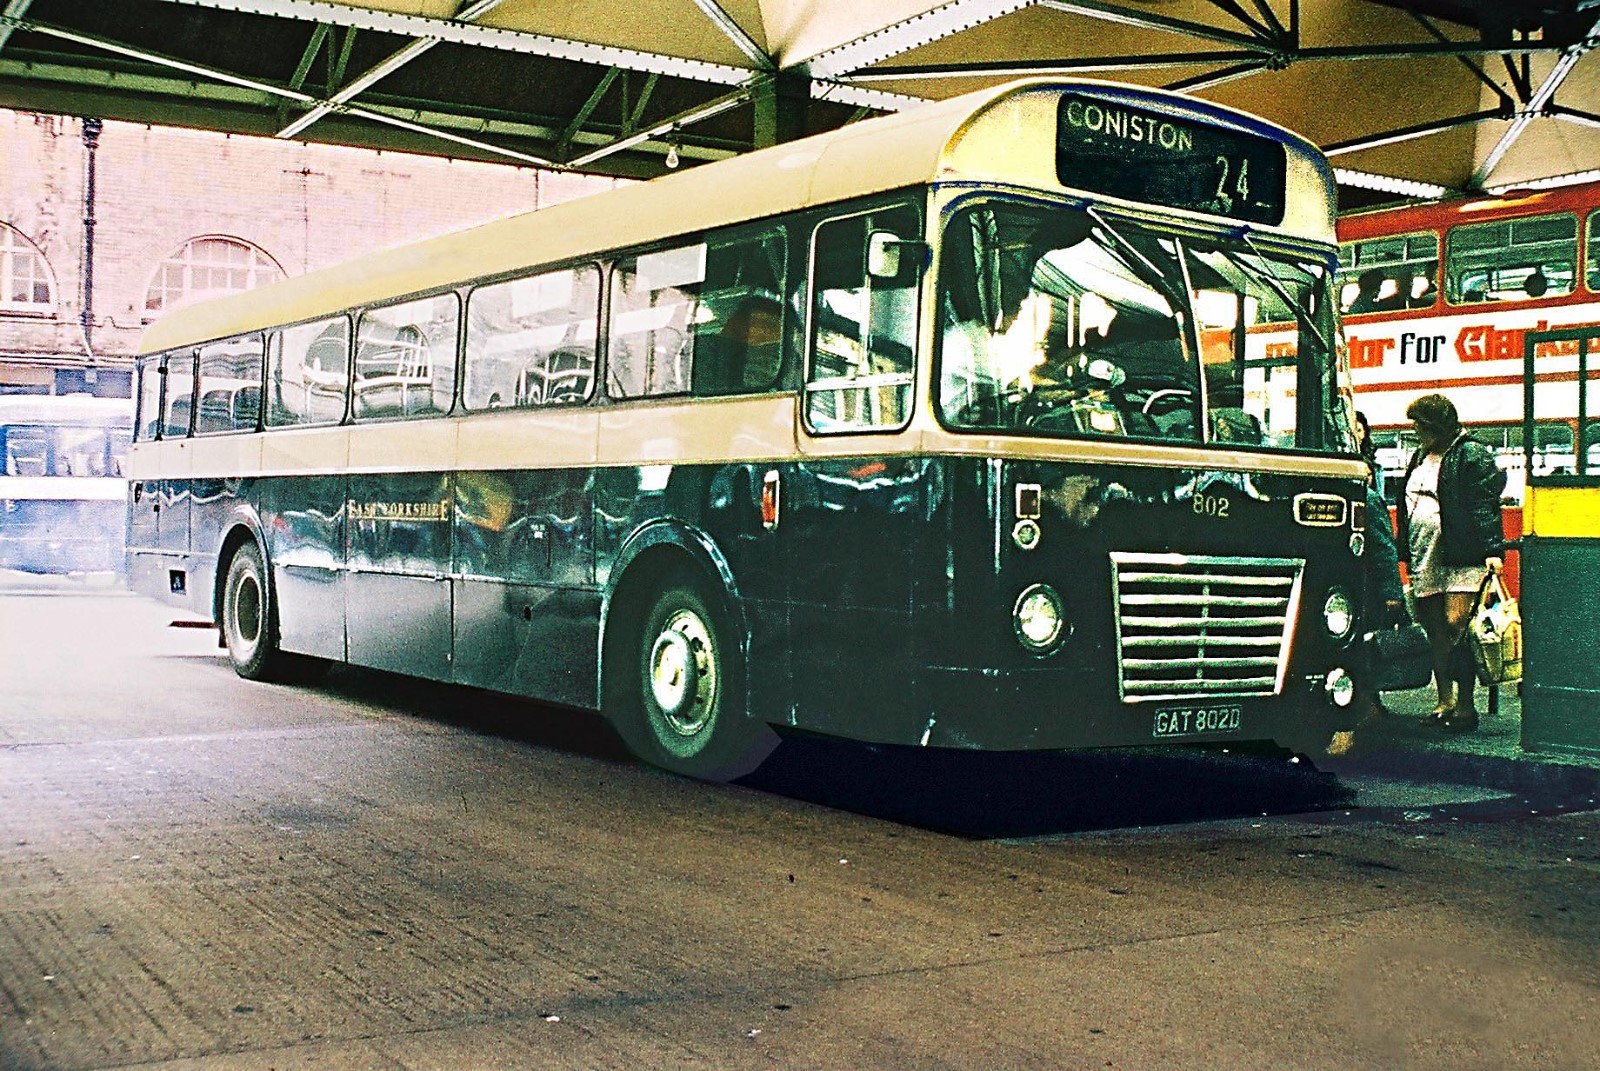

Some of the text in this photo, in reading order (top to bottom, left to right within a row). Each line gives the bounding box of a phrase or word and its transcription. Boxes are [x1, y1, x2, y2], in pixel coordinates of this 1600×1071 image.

[1066, 101, 1192, 151] CONISTON
[1216, 156, 1249, 201] 24
[1400, 332, 1446, 365] for
[378, 500, 449, 521] YORKSHIRE
[1193, 493, 1229, 518] 802
